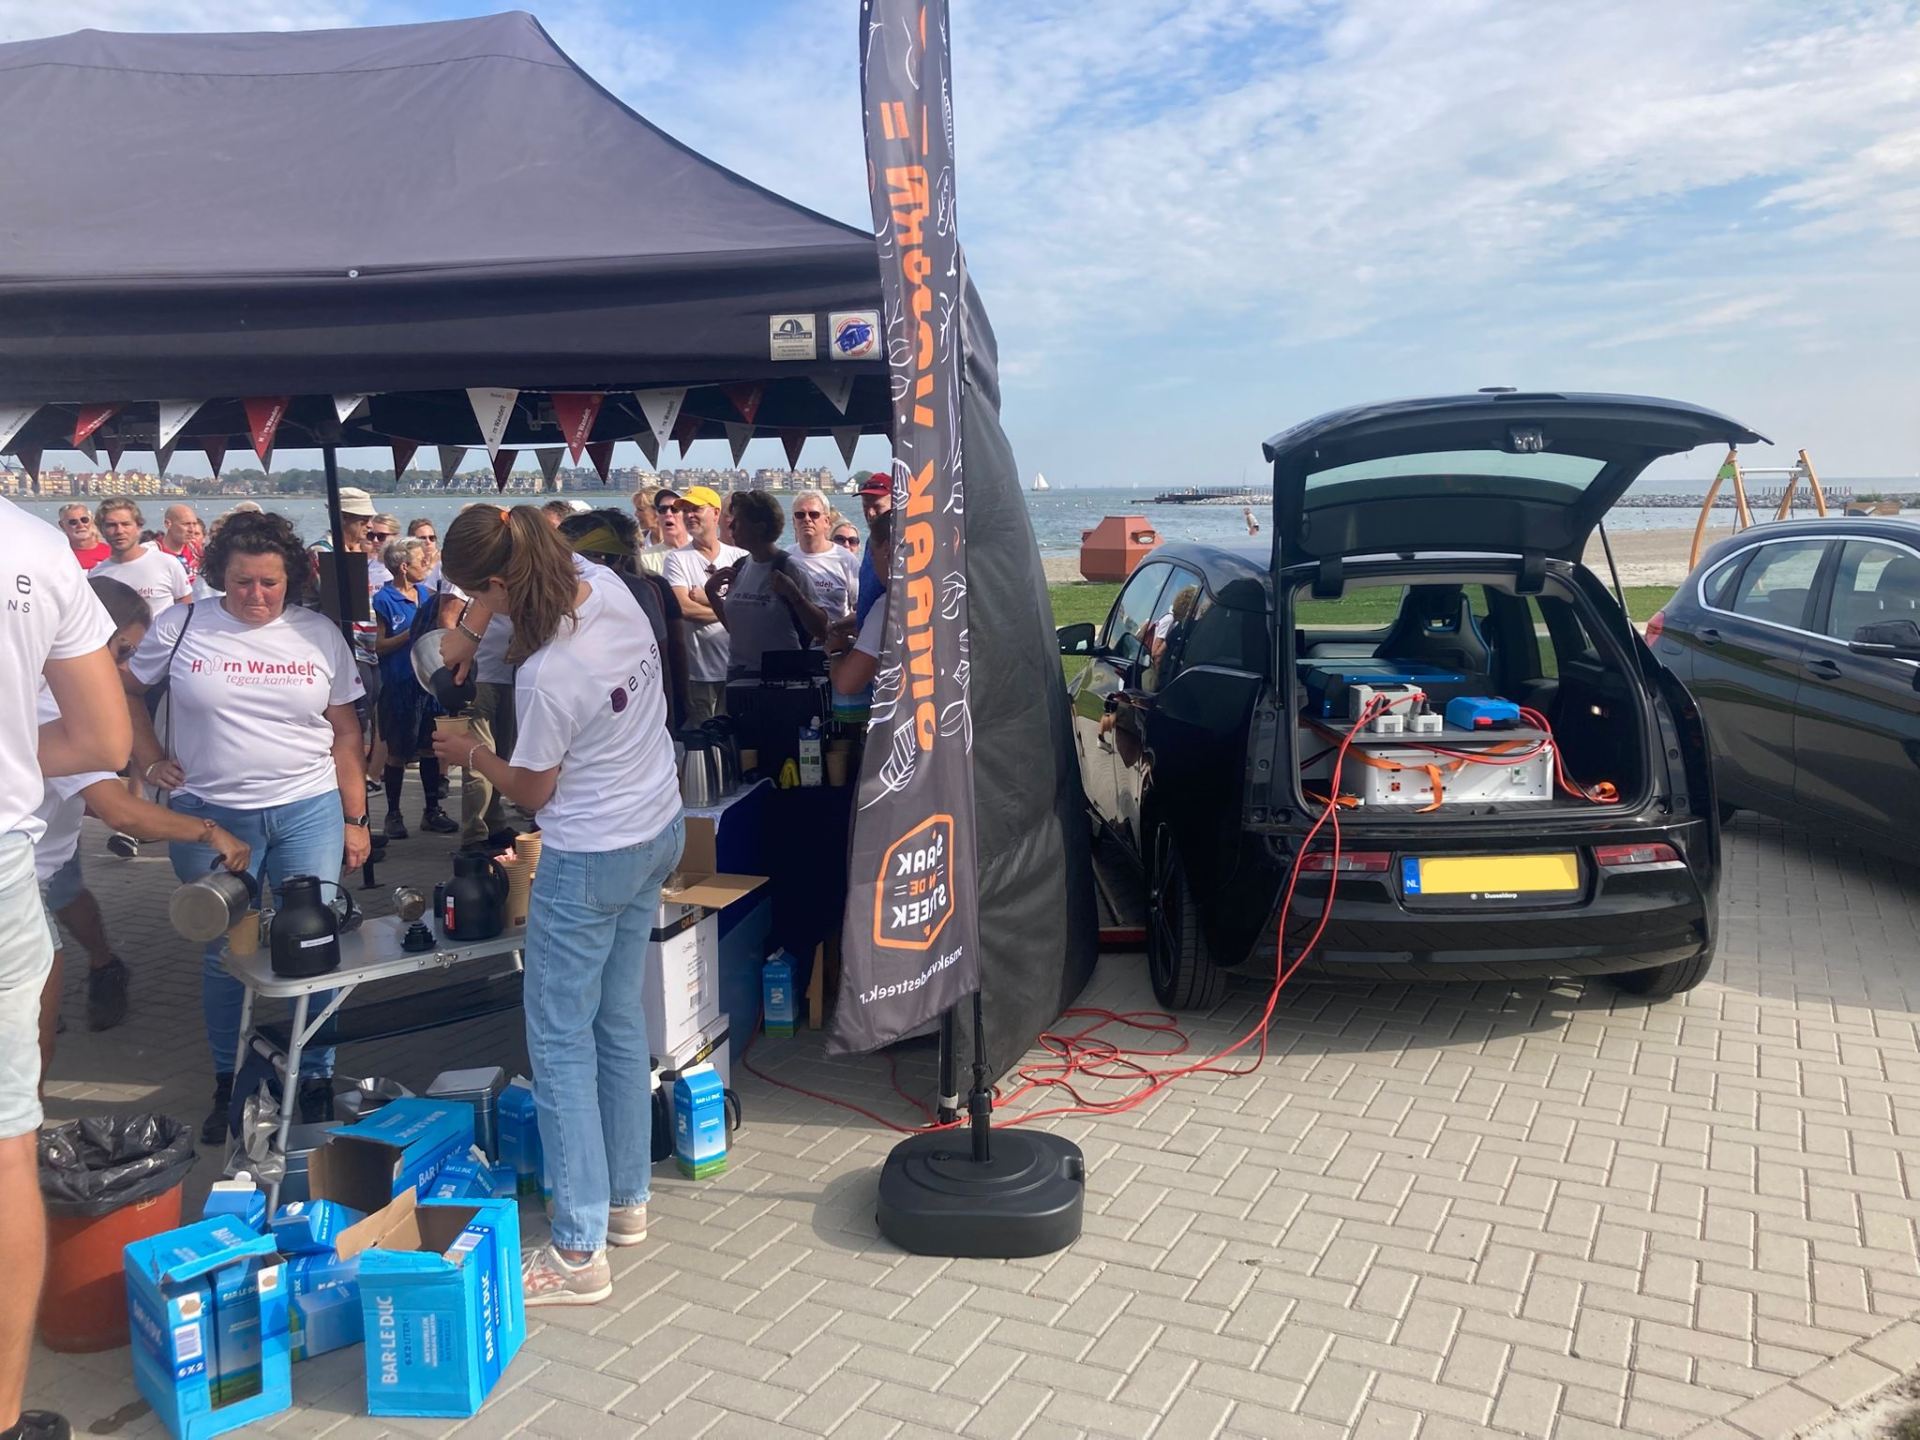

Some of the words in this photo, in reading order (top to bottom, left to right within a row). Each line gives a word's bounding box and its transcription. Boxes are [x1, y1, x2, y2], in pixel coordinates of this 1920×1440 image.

[247, 660, 316, 677] Wandelt
[226, 674, 260, 686] tegen
[263, 675, 304, 686] kanker
[1406, 880, 1419, 888] NL
[178, 1362, 205, 1378] 6X2
